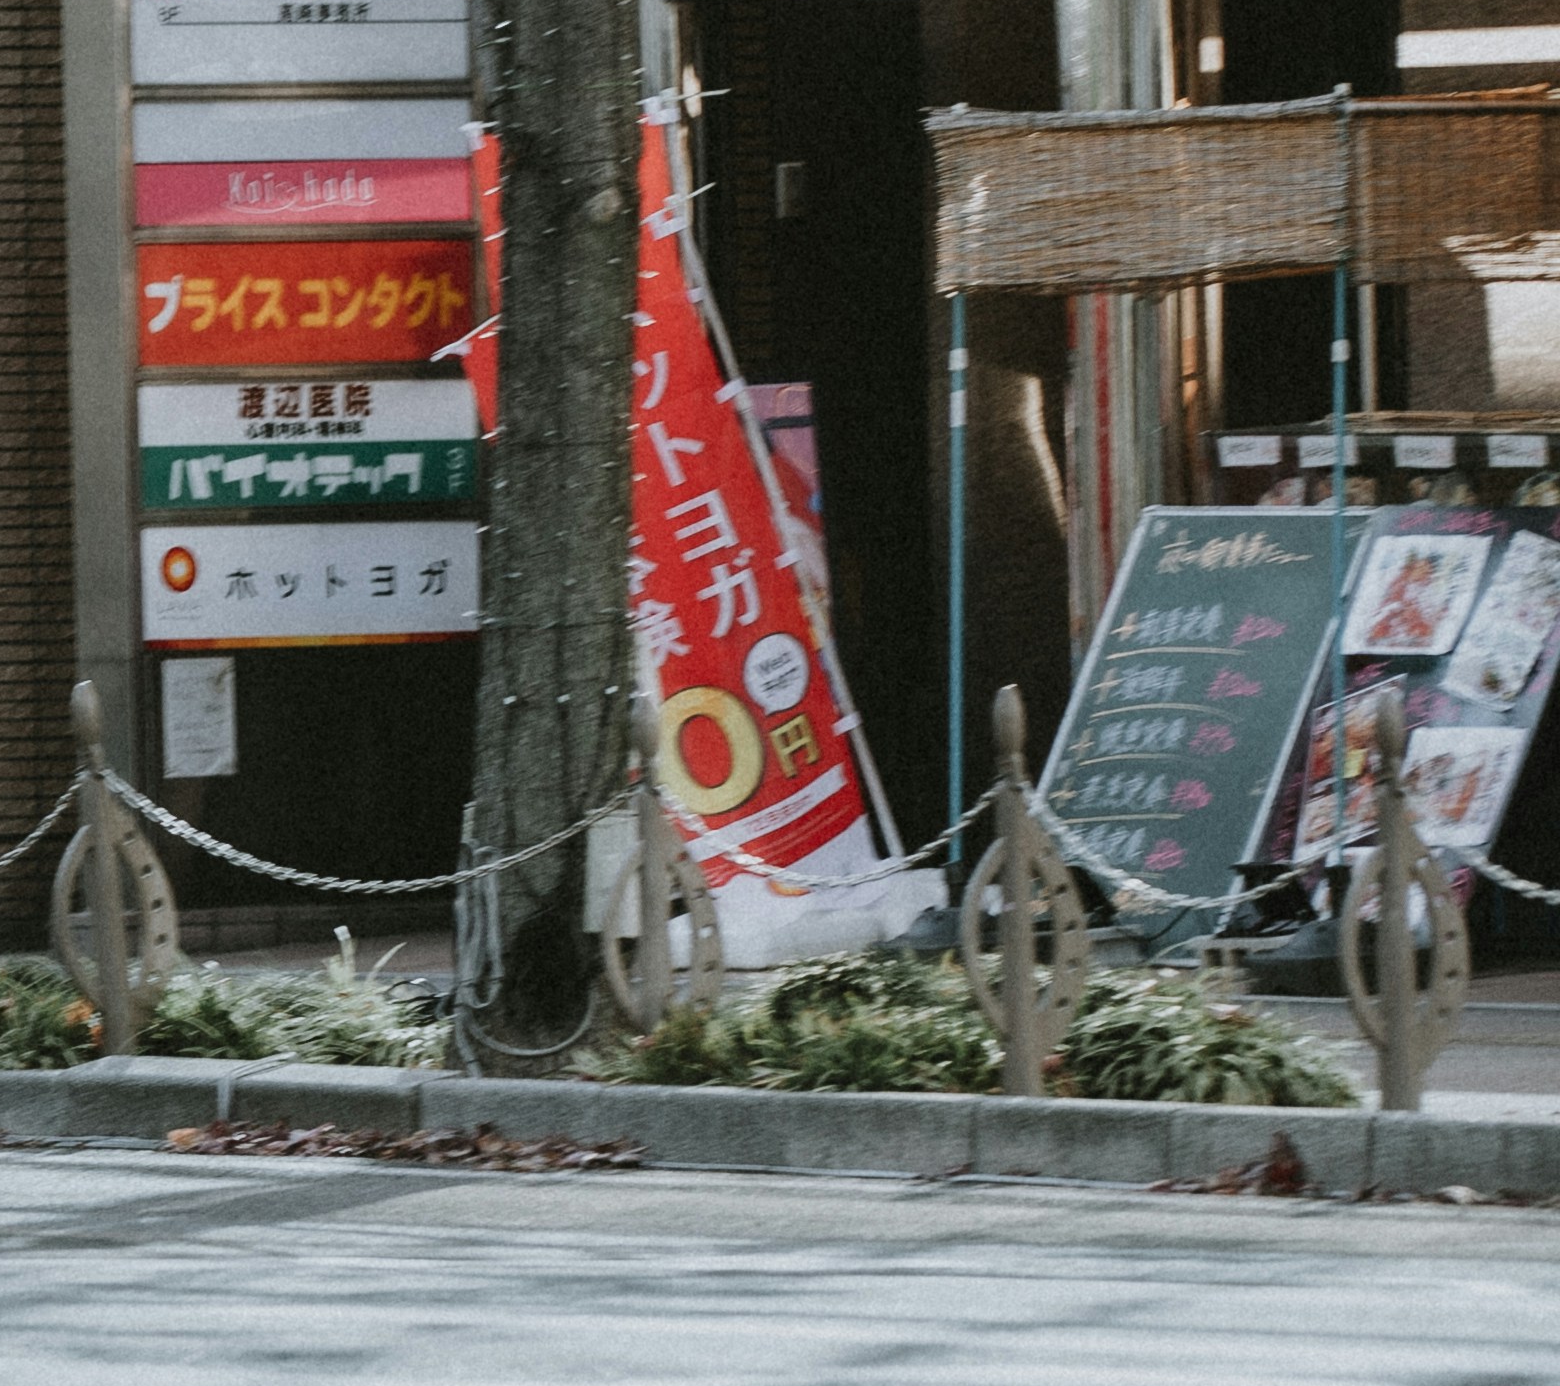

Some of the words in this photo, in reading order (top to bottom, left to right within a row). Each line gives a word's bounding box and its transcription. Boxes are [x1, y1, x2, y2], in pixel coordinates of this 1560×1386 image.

[145, 273, 290, 334] プライス
[297, 271, 466, 332] コンタクト
[238, 384, 372, 419] 渡辺医院
[169, 450, 424, 500] バイオテック
[224, 557, 454, 601] ホットヨガ
